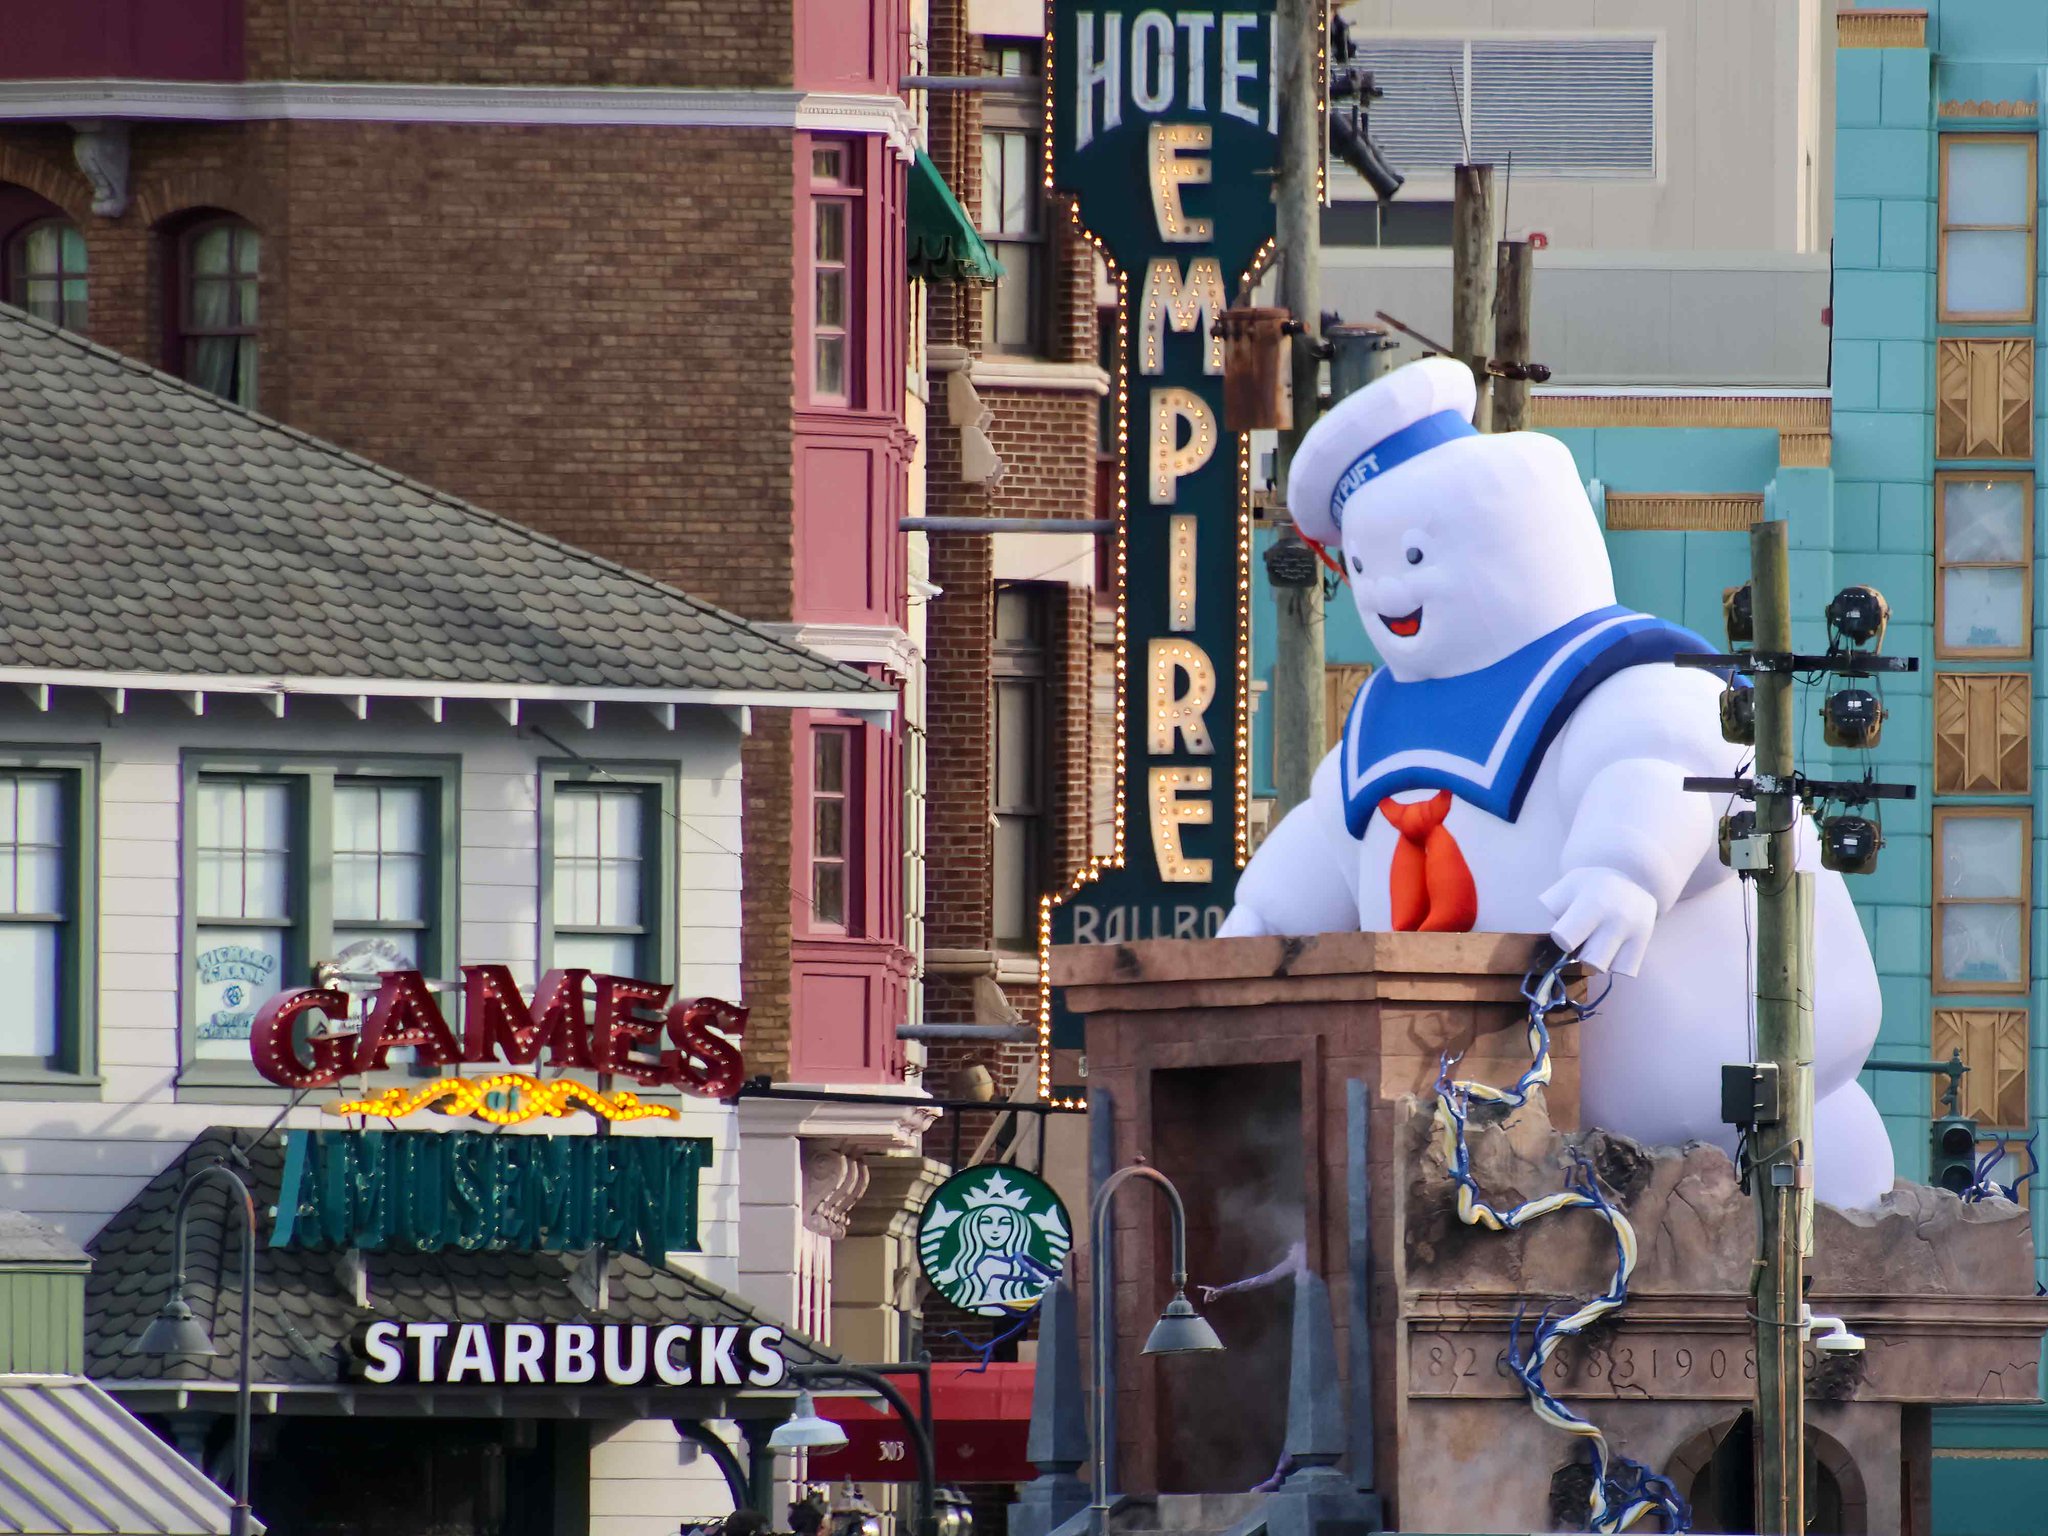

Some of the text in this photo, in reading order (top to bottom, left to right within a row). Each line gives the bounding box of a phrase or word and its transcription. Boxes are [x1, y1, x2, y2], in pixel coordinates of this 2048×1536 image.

[1139, 123, 1227, 883] EMPIRE
[250, 964, 751, 1098] GAMES
[363, 1321, 785, 1386] STARBUCKS
